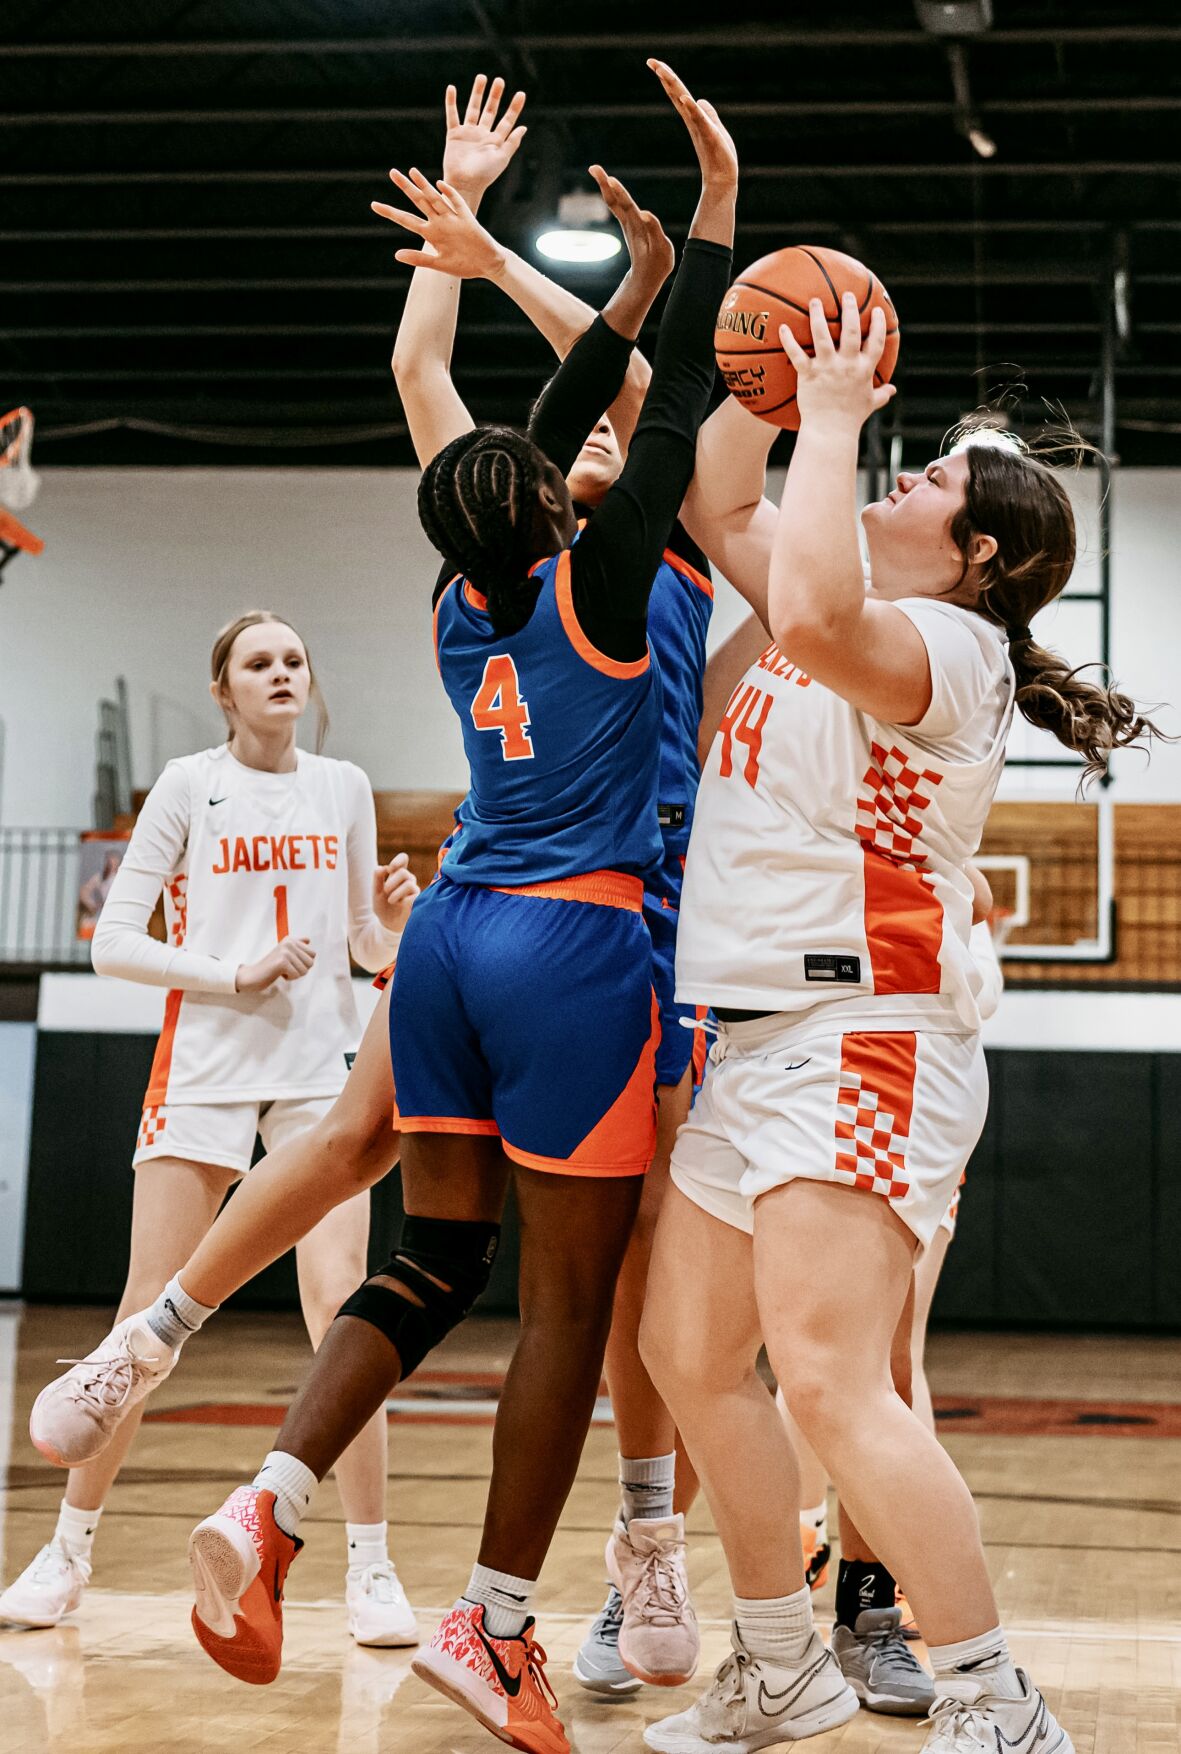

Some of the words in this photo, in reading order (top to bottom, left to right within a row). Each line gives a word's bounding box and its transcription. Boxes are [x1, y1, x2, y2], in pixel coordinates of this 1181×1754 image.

[470, 653, 535, 761] 4
[718, 681, 774, 789] 44
[675, 810, 682, 820] M
[212, 834, 339, 874] JACKETS
[273, 884, 289, 943] 1
[841, 965, 854, 974] XXL
